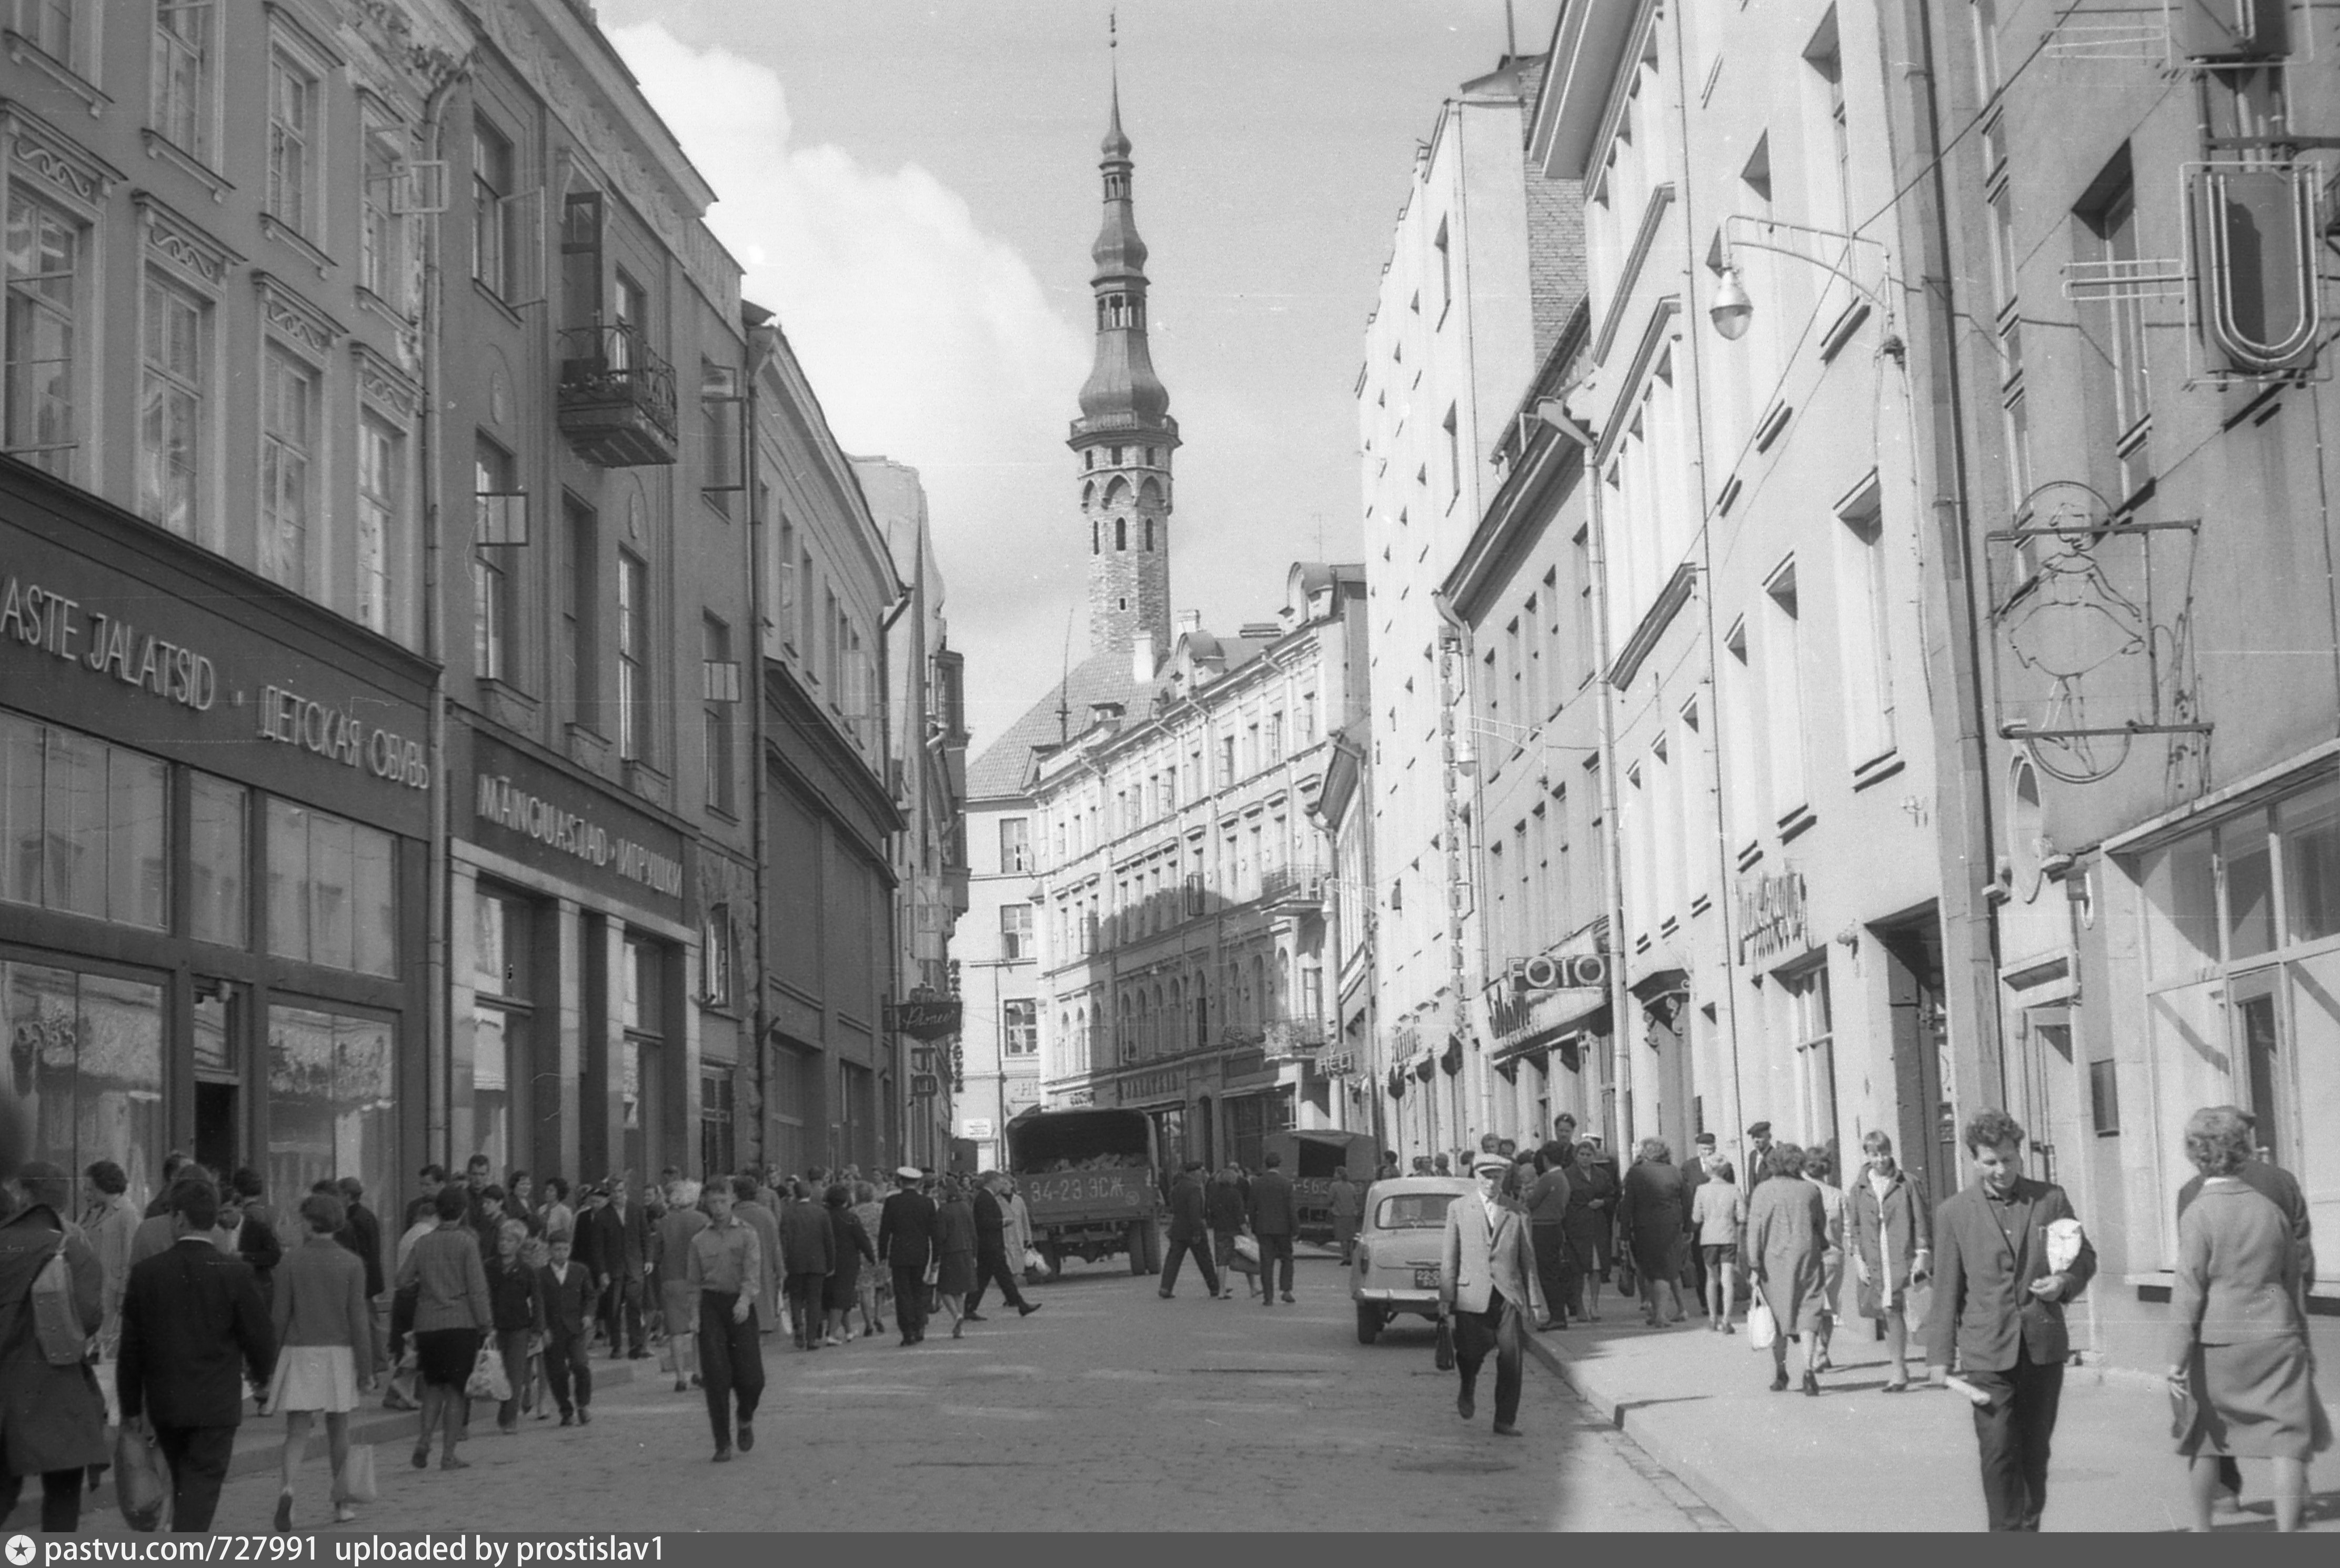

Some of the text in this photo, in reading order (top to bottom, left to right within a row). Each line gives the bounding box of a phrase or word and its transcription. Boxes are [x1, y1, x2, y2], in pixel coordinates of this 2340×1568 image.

[88, 610, 213, 710] JALATSID
[262, 685, 429, 789] ДЕТСКАЯ ОБУВЬ
[1506, 954, 1605, 991] FOTO
[1030, 1179, 1082, 1202] 34-23
